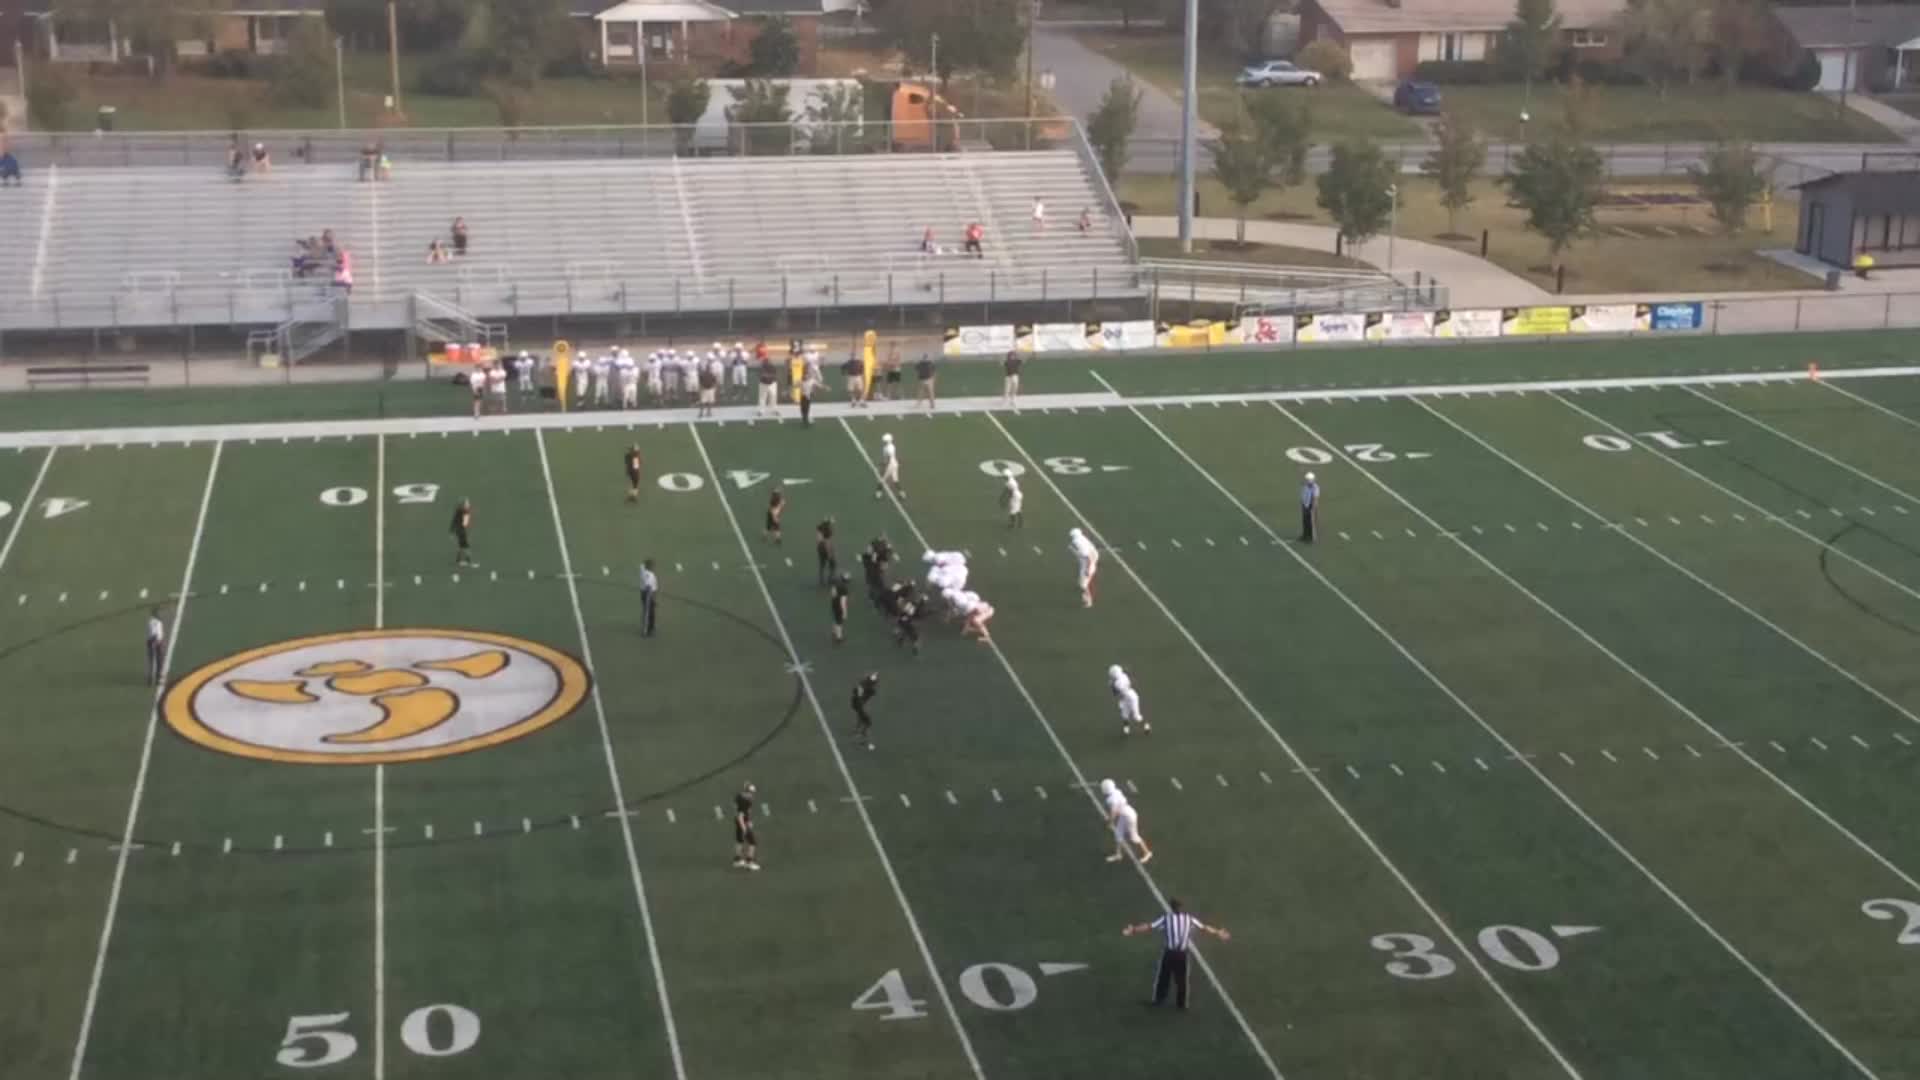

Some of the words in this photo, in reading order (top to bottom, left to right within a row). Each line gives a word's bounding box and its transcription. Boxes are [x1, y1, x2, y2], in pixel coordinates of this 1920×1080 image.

[1583, 430, 1697, 451] 10
[1285, 443, 1397, 465] 20
[979, 456, 1093, 477] 30
[657, 469, 770, 491] 40
[319, 483, 441, 506] 50
[1370, 924, 1561, 980] 30
[850, 962, 1039, 1021] 40
[275, 1003, 482, 1069] 50
